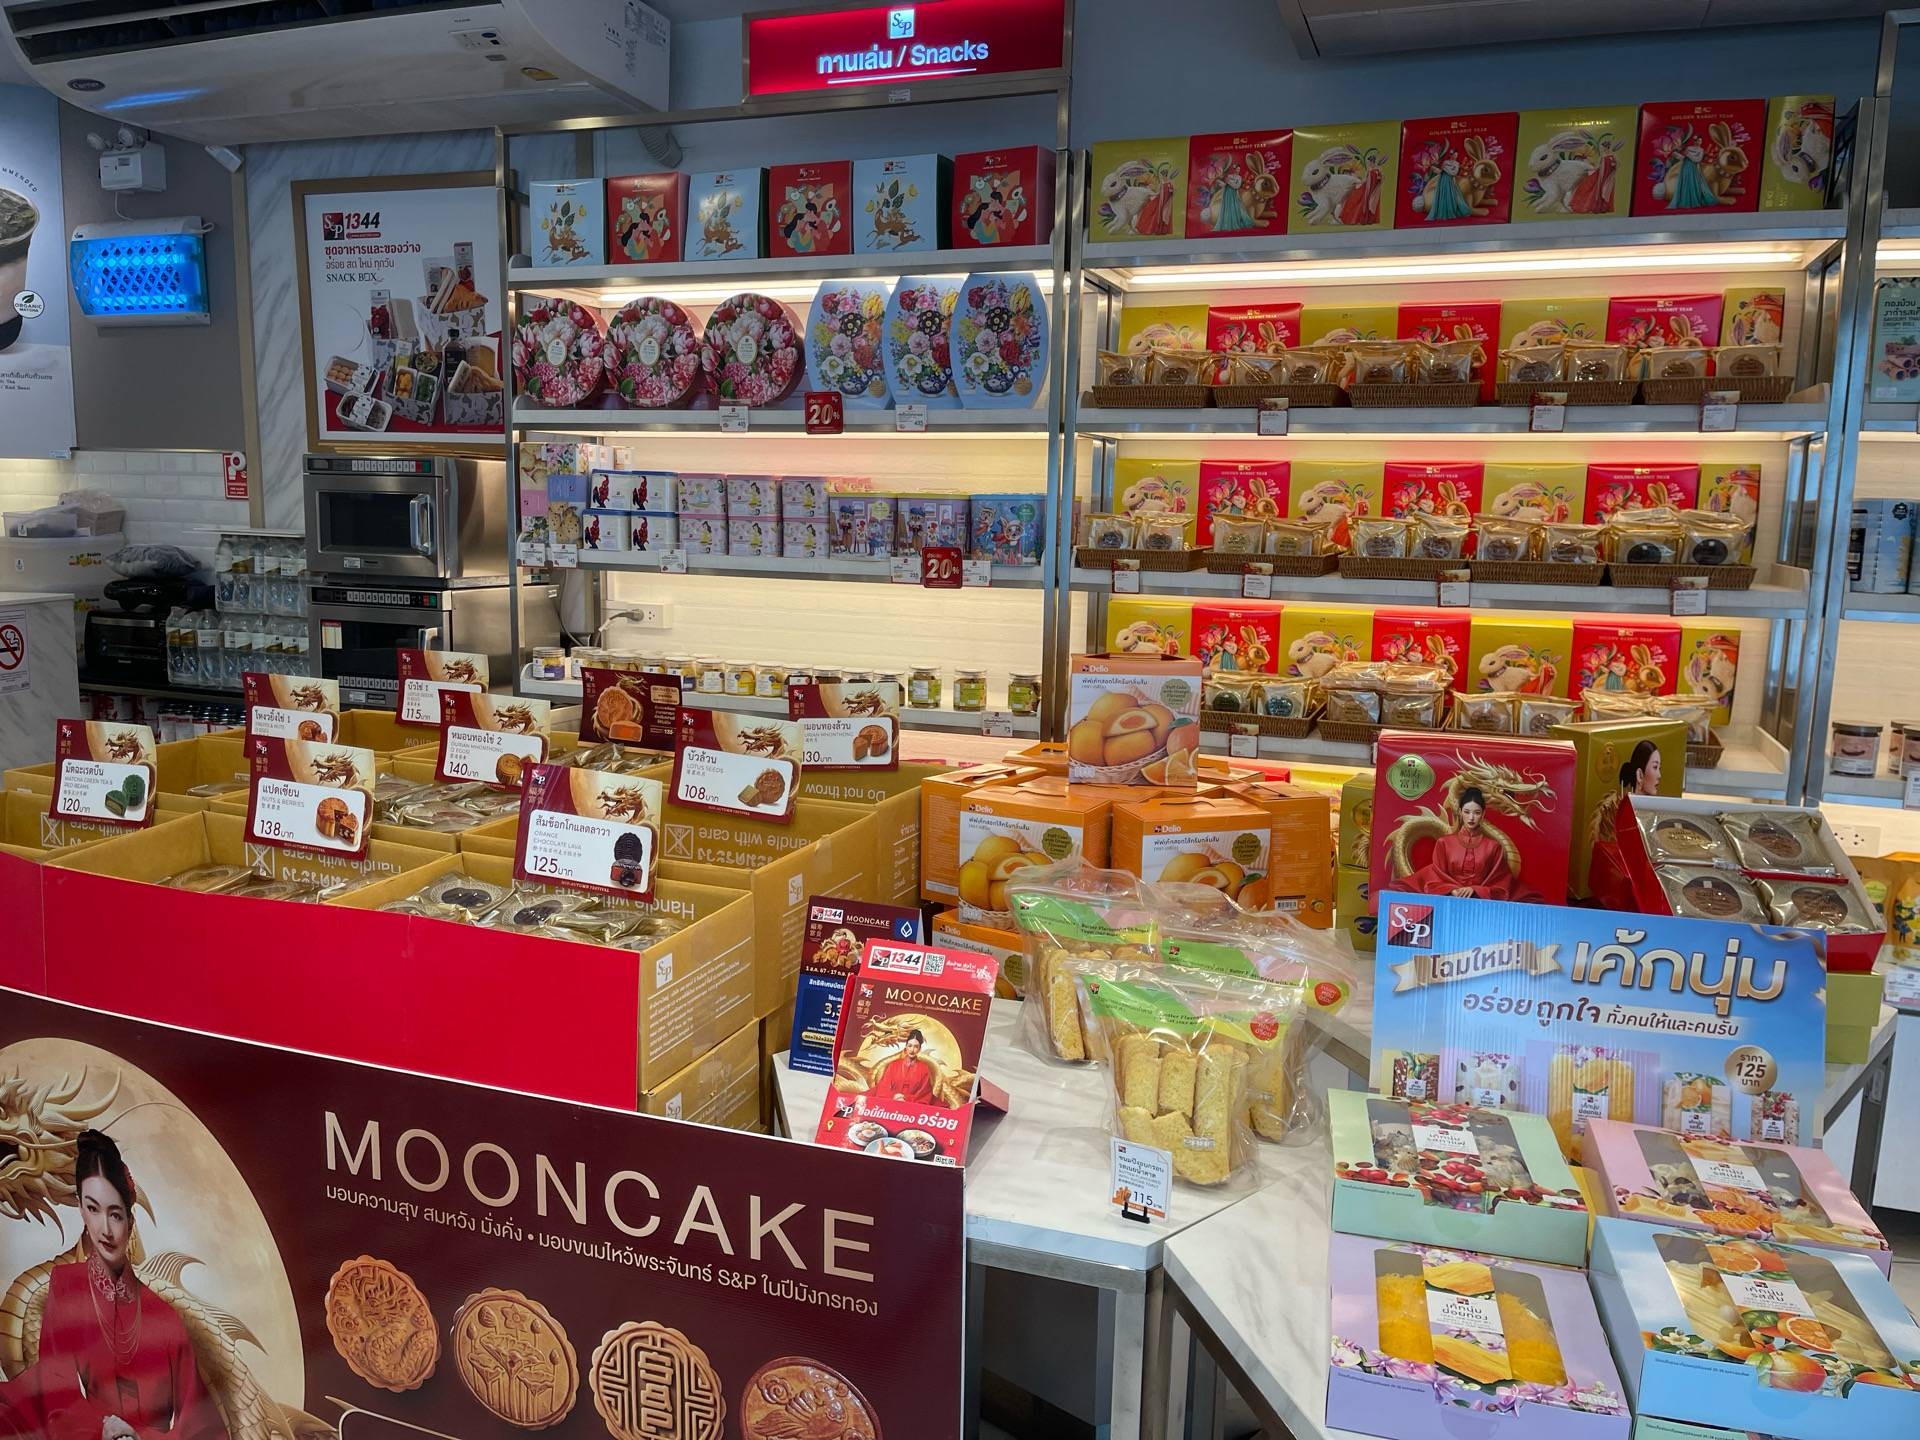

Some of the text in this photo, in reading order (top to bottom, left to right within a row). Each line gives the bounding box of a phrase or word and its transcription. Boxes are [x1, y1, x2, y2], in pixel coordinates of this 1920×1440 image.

[818, 39, 989, 74] ทานเล่น / Snacks
[345, 212, 380, 230] 1344
[325, 241, 421, 259] ชุดอาหารและของว่าง
[326, 273, 356, 283] SNACK
[406, 708, 421, 719] 115
[688, 751, 717, 764] บัวล้วน
[802, 751, 820, 762] 130
[449, 762, 468, 775] 140
[262, 784, 300, 798] แปดเซียน
[685, 784, 706, 800] 108
[805, 784, 840, 799] throw
[844, 788, 864, 799] not
[62, 798, 80, 812] 120
[260, 820, 281, 836] 138
[699, 828, 812, 849] andle with care
[533, 855, 573, 877] 125 บาท
[824, 909, 842, 919] 1344
[846, 915, 891, 928] MOONCAKE
[1391, 906, 1430, 945] S&P
[891, 952, 922, 966] 1344
[1430, 928, 1787, 1018] โฉมใหม่! เค้กนุ่ม
[886, 987, 983, 1011] MOONCAKE
[1463, 986, 1739, 1038] อร่อย ถูกใจ ทั้งคนให้และคนรับ
[1739, 1054, 1763, 1063] ราคา
[1735, 1063, 1767, 1079] 125
[1741, 1078, 1760, 1087] บาท
[917, 1111, 958, 1130] อร่อย
[323, 1110, 875, 1282] MOONCAKE
[1134, 1191, 1153, 1206] 115
[325, 1184, 878, 1317] มอบความสุข สมหวัง มั่งคั่ง มอบขนมไหว้พระจันทร์ S&P ในปีมังกรทอง
